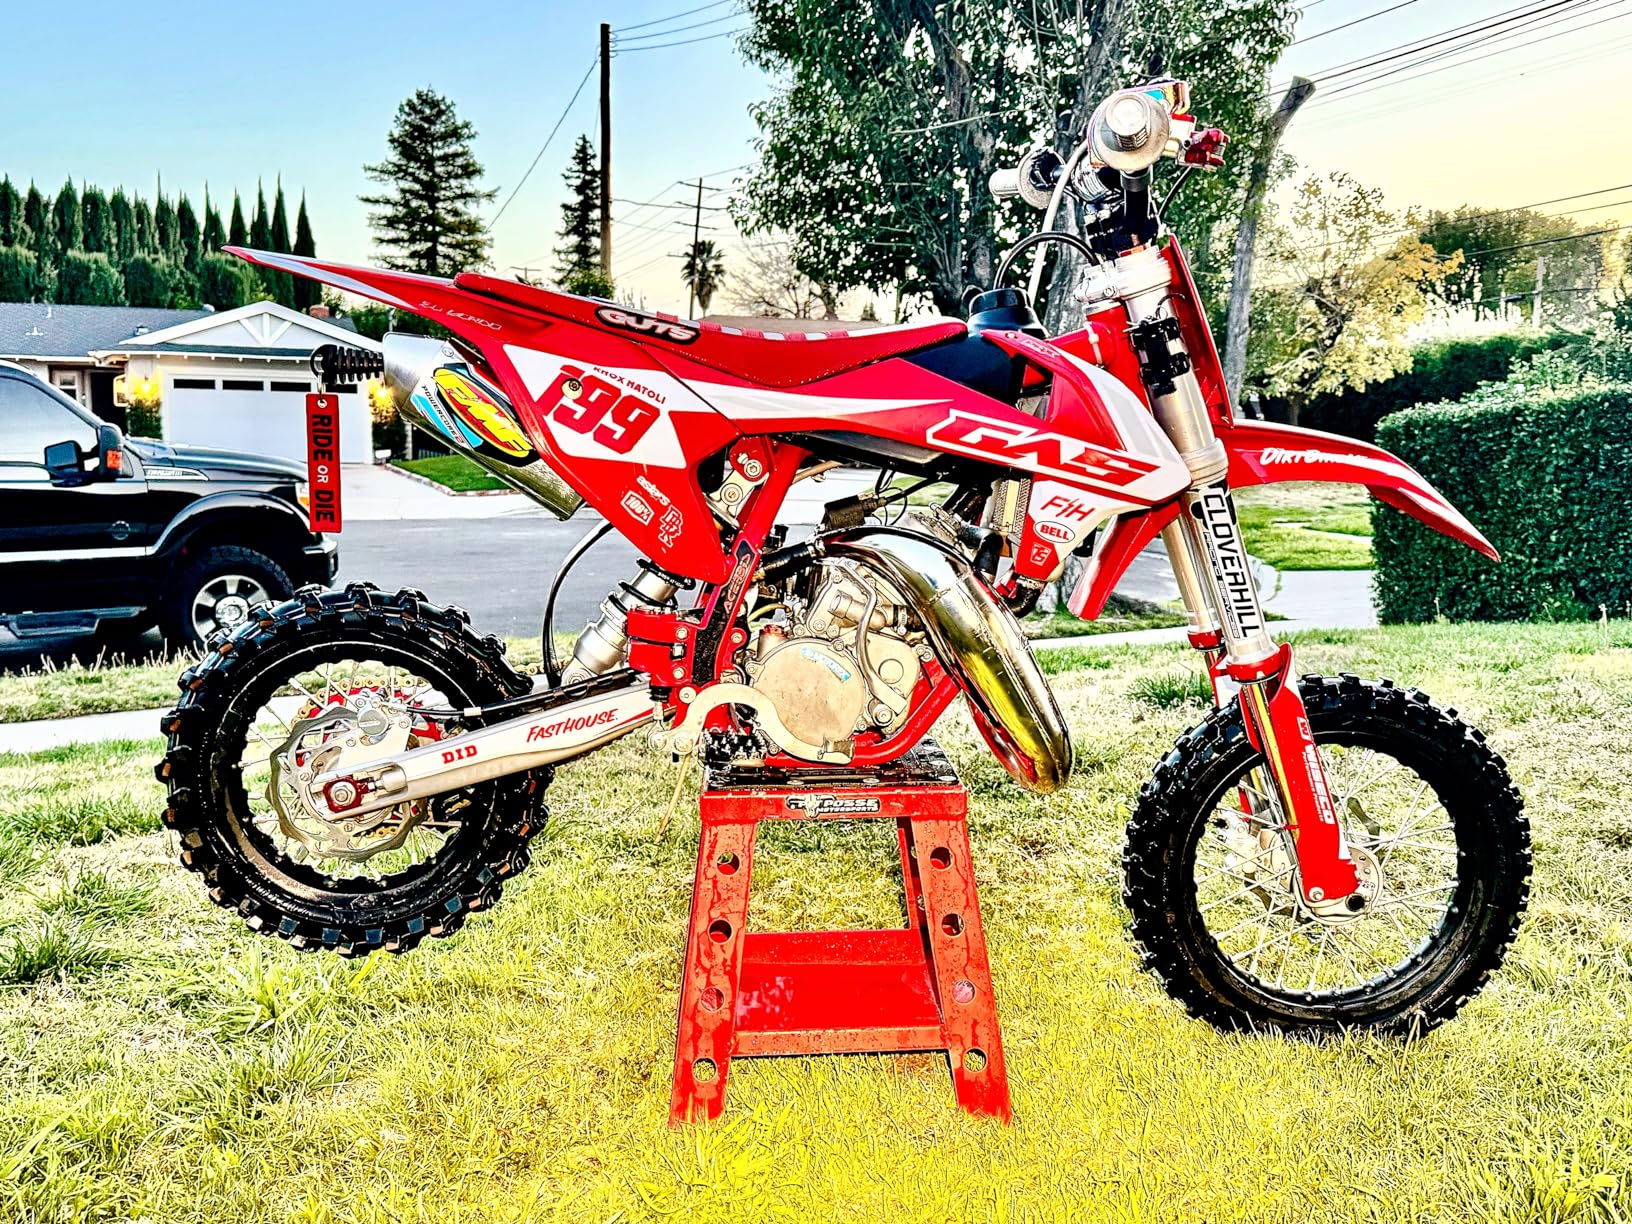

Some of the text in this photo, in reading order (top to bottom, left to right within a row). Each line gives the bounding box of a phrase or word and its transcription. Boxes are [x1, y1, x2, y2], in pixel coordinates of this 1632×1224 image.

[598, 308, 697, 341] GUTS
[421, 385, 458, 438] POWERCORE
[593, 366, 667, 405] KNOX NATOLI
[431, 373, 535, 452] FMF
[311, 413, 336, 523] RIDE OR DIE
[928, 409, 1161, 487] GAS
[1040, 523, 1069, 541] BELL
[1203, 494, 1260, 638] CLOVERHILL
[441, 745, 478, 764] DID
[823, 799, 878, 807] POSSE
[1304, 743, 1335, 825] WISECO
